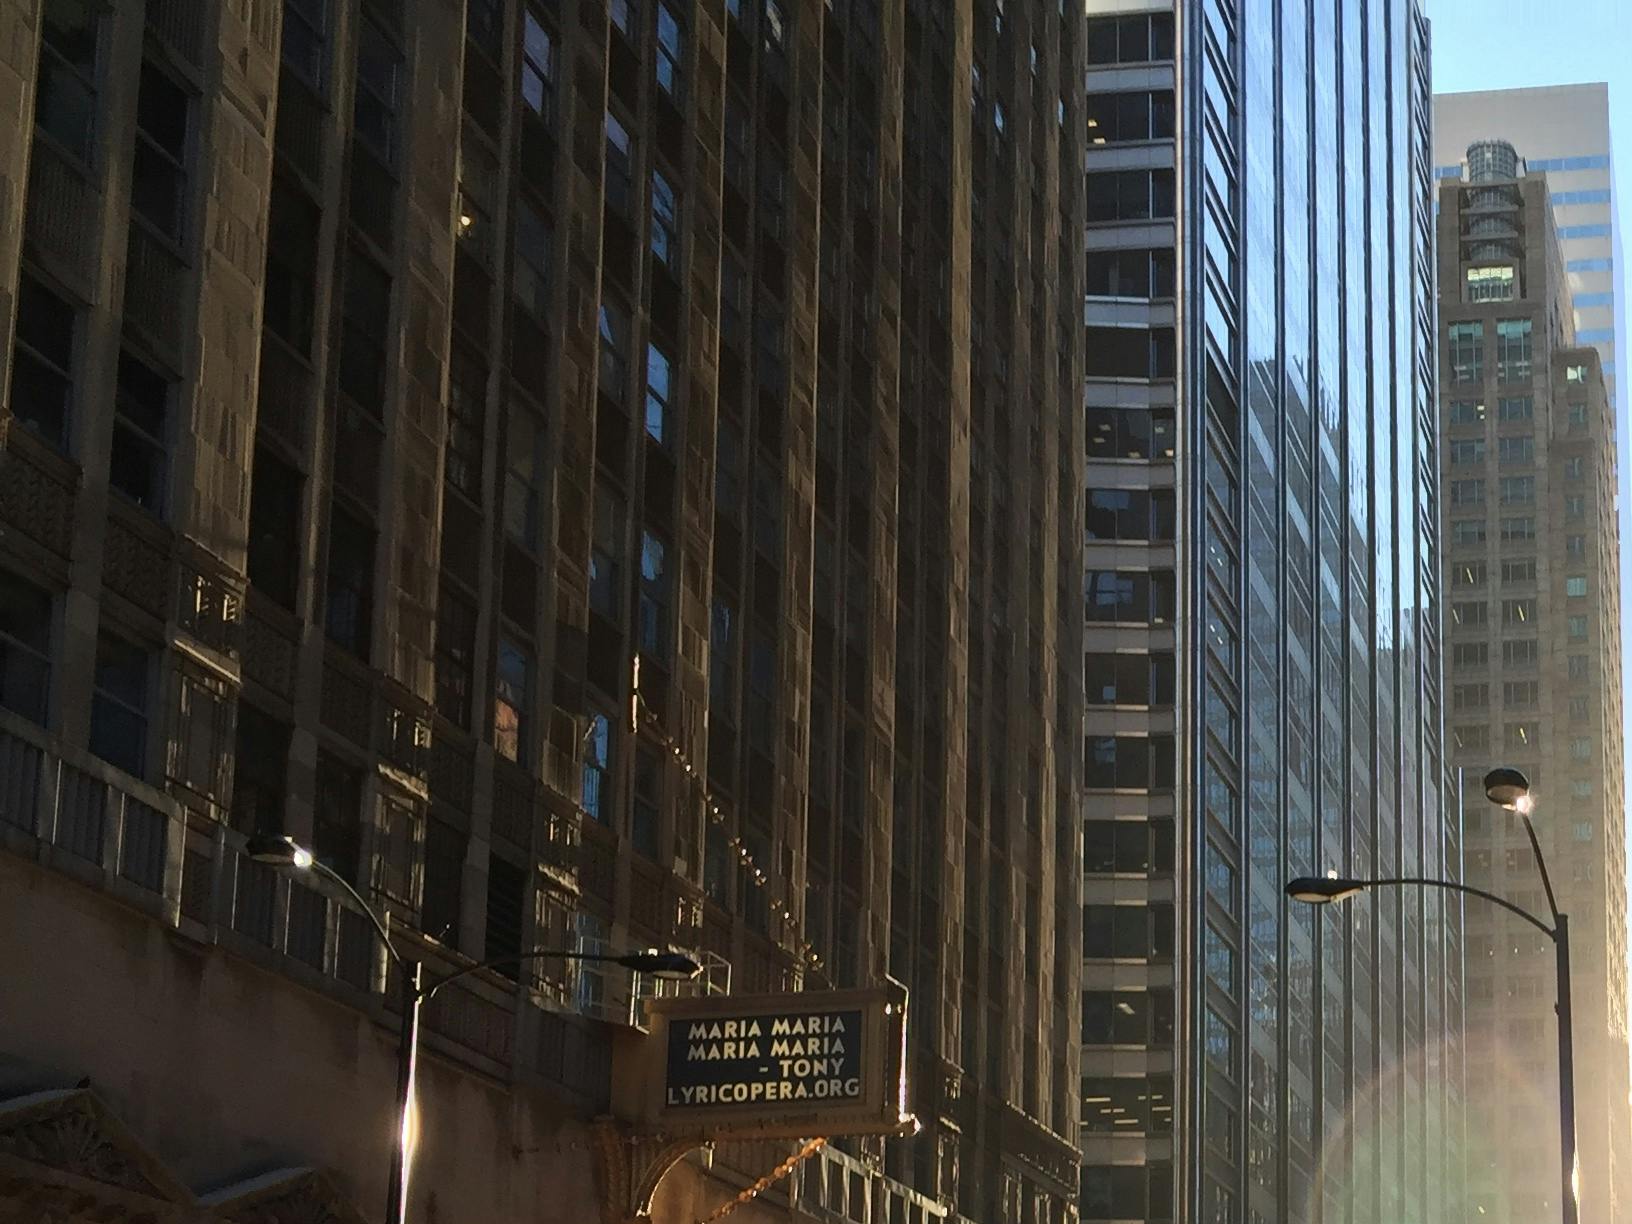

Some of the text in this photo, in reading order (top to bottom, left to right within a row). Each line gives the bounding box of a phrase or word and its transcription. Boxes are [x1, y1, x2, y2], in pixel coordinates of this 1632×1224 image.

[688, 1015, 846, 1041] MARIA MARIA
[687, 1036, 845, 1062] MARIA MARIA
[779, 1057, 845, 1079] TONY
[667, 1077, 861, 1105] LYRICOPERA.ORG
